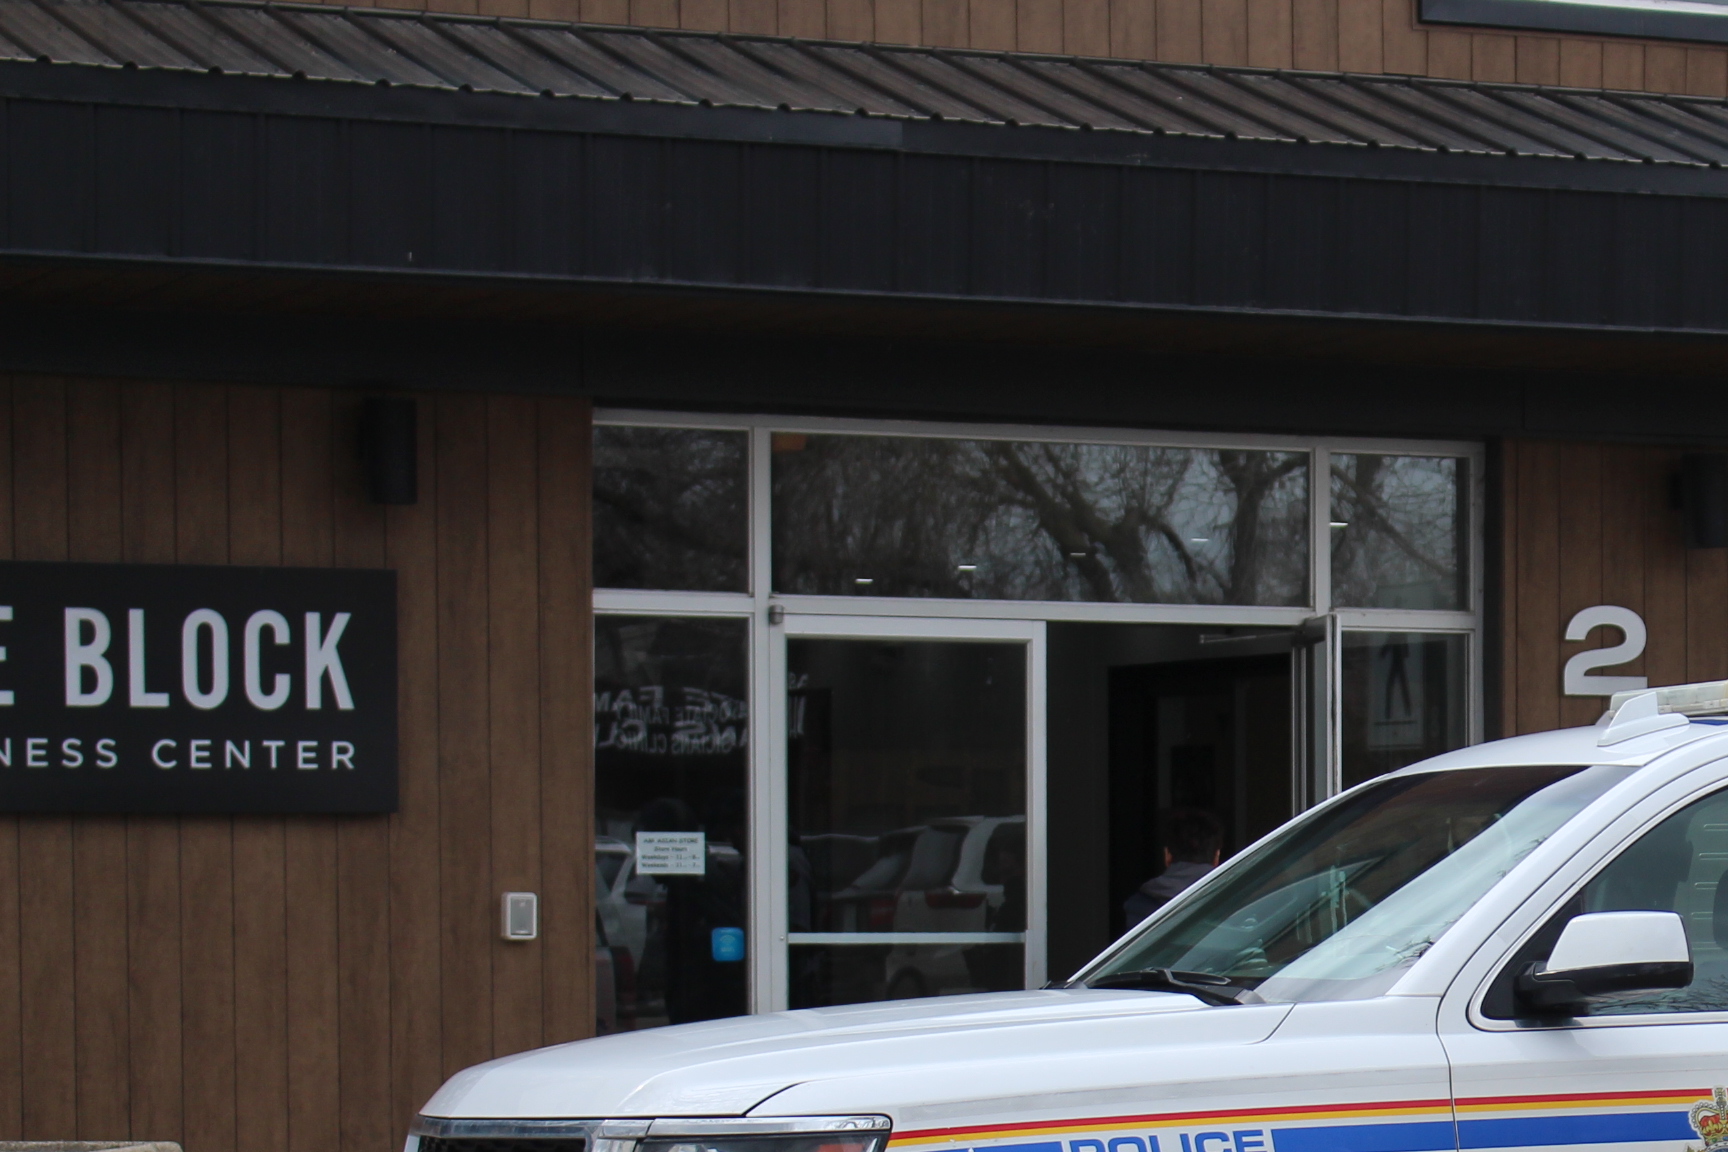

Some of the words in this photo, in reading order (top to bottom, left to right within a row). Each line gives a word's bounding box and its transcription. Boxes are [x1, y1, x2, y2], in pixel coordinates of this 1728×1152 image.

[65, 607, 355, 711] BLOCK
[1563, 604, 1648, 696] 2
[152, 739, 355, 769] CENTER
